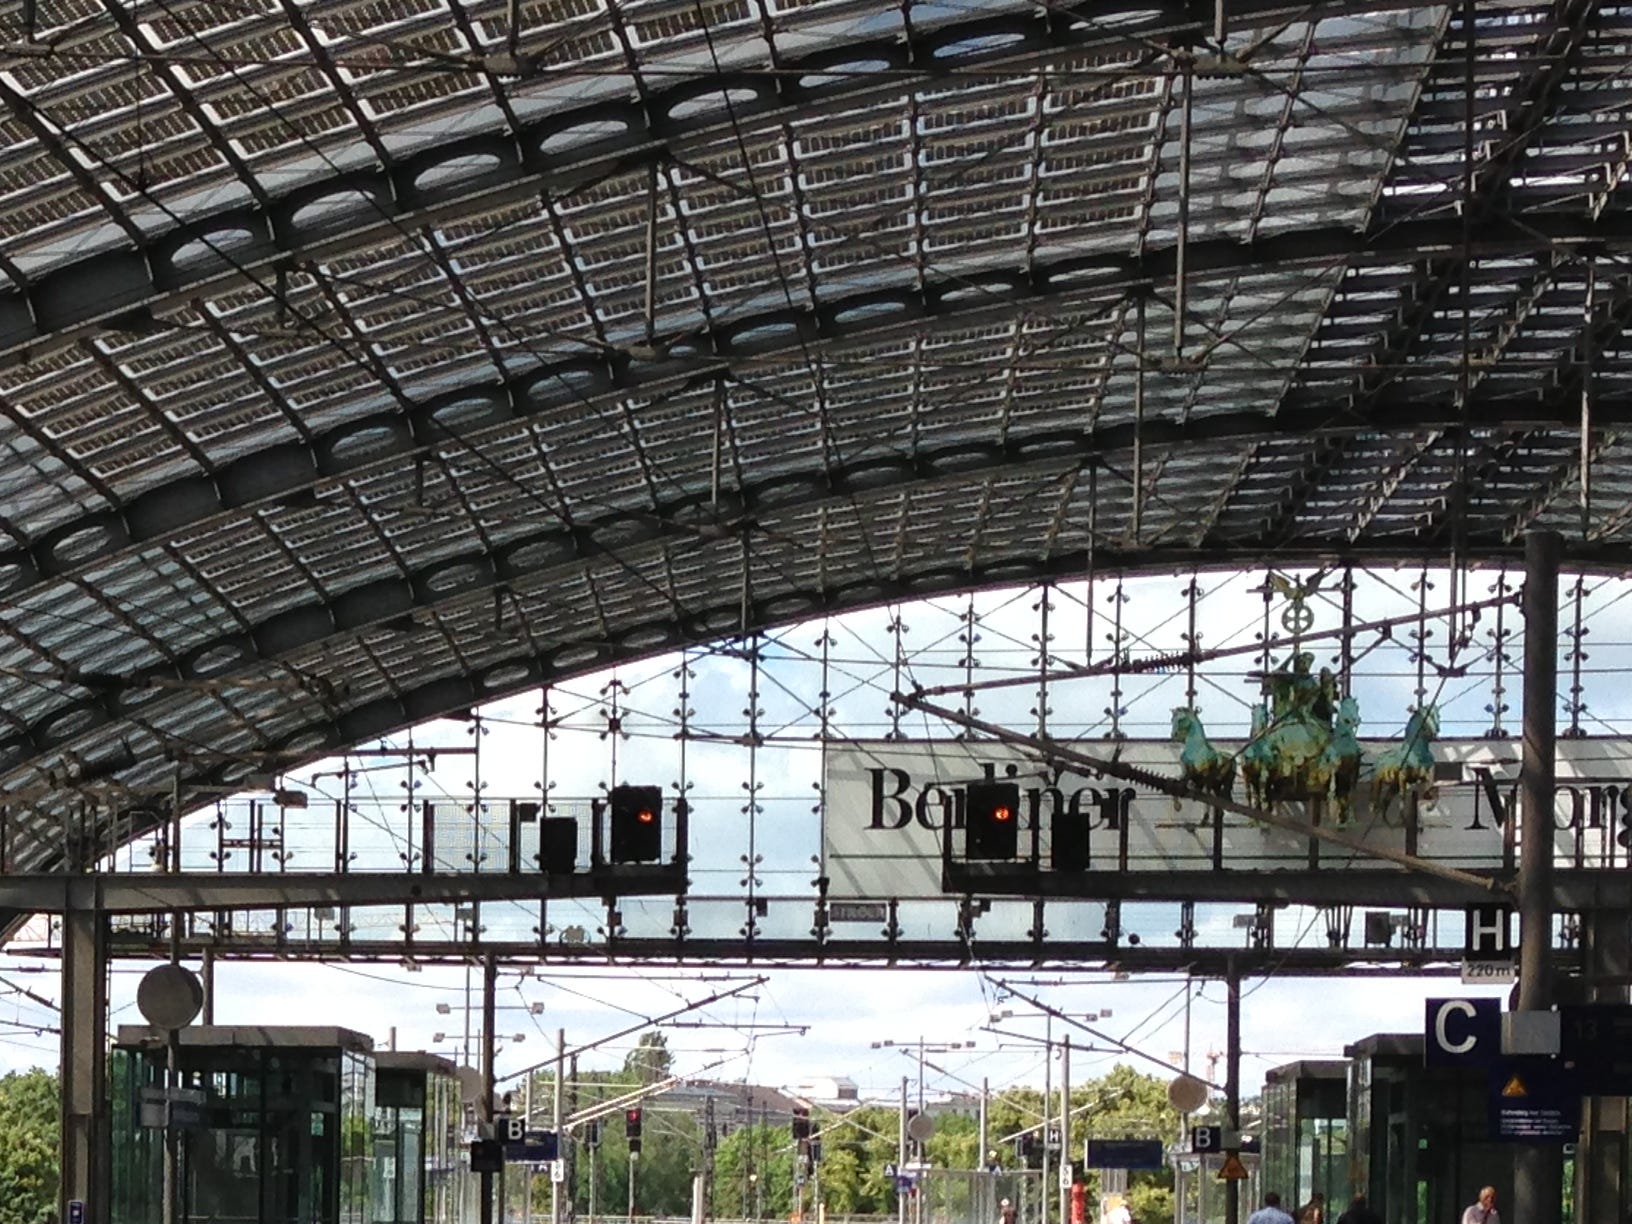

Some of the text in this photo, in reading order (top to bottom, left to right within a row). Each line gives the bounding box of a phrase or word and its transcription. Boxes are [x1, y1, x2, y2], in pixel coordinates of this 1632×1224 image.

[1472, 909, 1504, 951] H
[1467, 963, 1511, 978] 220 m
[1435, 999, 1478, 1054] C
[508, 1119, 524, 1140] B
[1195, 1127, 1211, 1148] B
